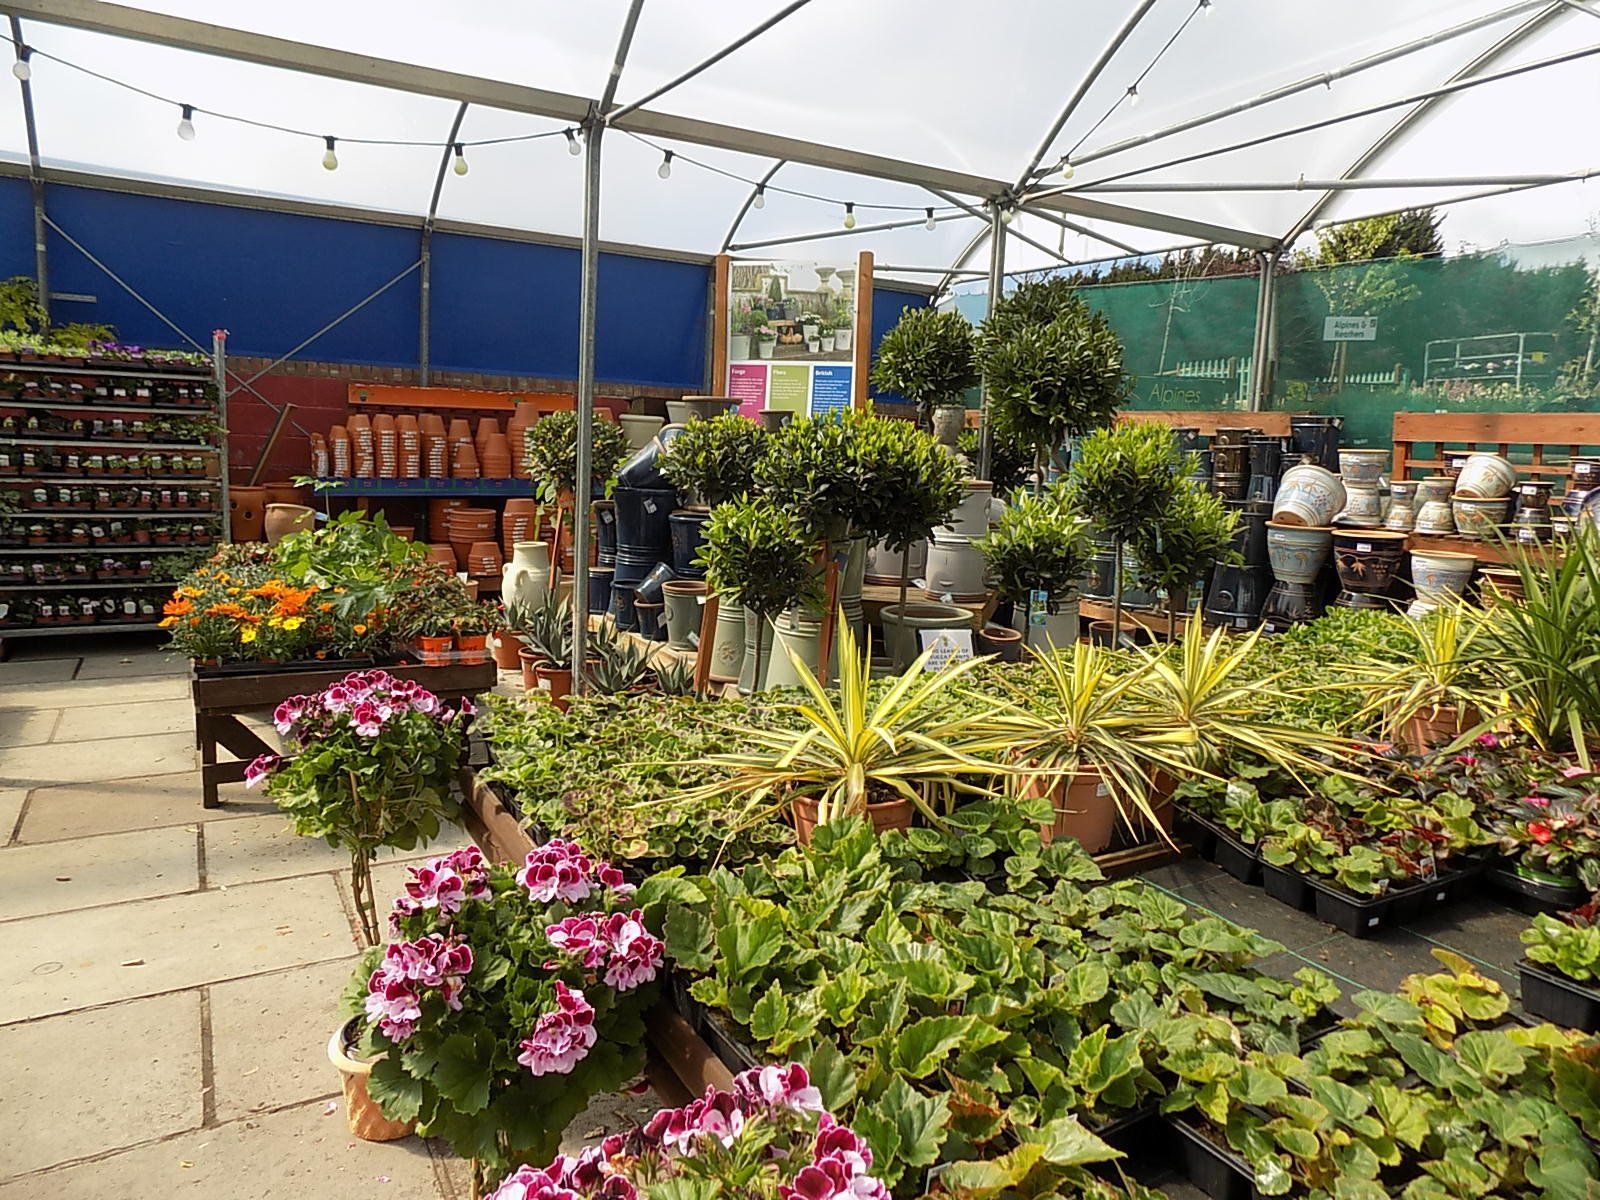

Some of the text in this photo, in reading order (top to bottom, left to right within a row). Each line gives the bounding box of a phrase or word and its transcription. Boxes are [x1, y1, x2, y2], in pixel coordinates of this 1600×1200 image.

[1334, 320, 1360, 329] Alpines
[1334, 330, 1364, 338] Heathers
[1148, 383, 1201, 407] Alpines
